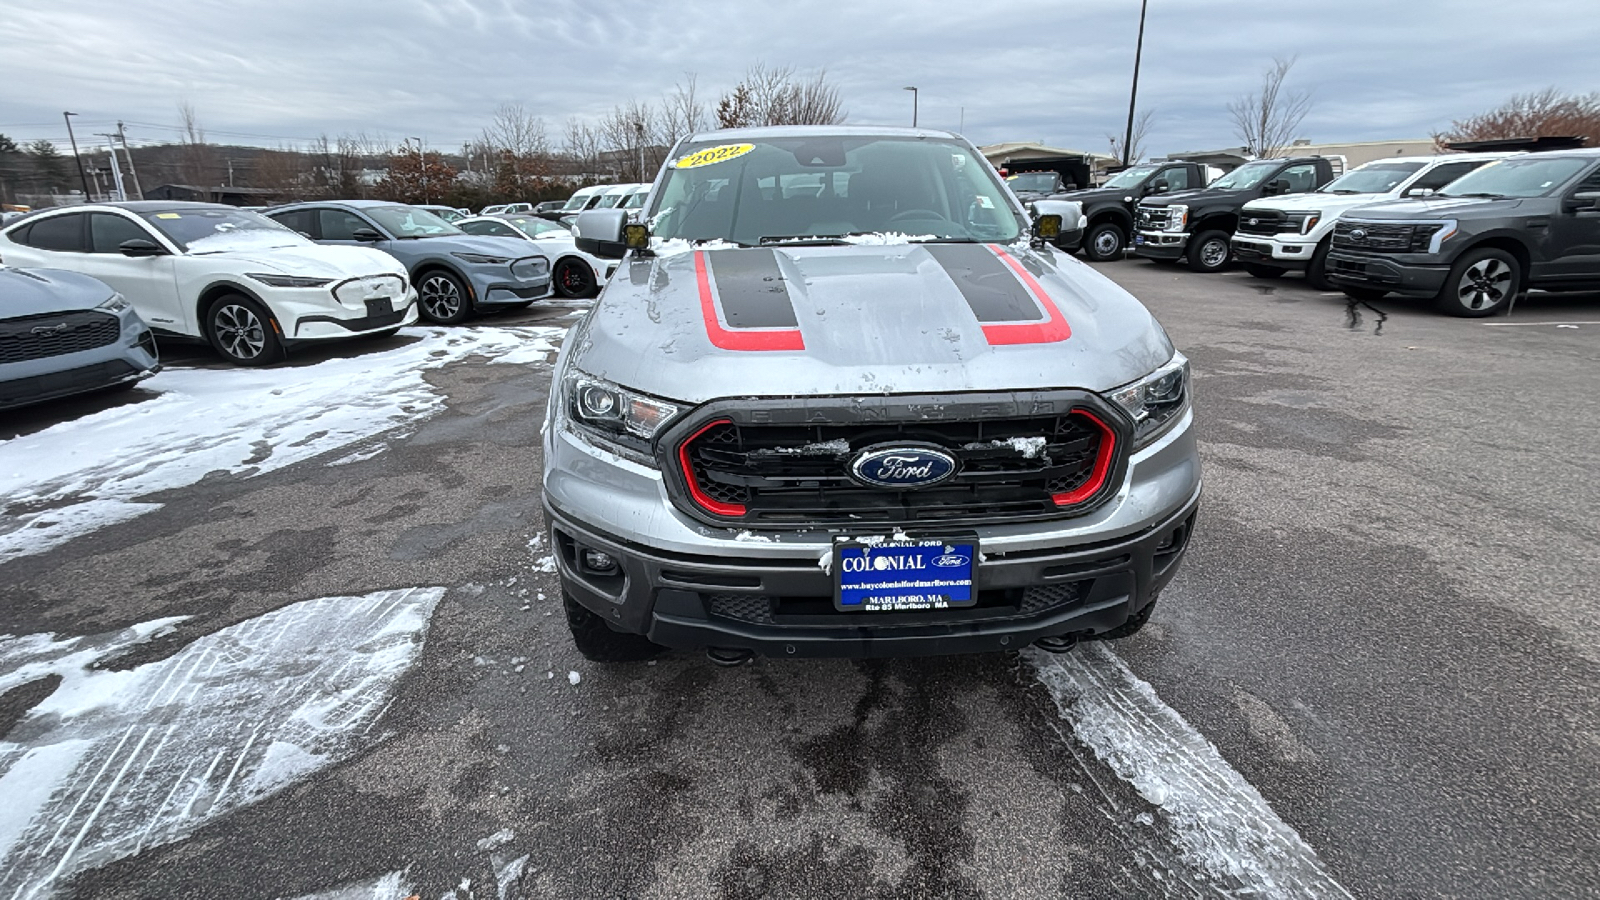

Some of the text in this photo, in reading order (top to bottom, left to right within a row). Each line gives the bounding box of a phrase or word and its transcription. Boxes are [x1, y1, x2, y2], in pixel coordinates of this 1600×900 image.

[690, 146, 741, 167] 2022
[877, 456, 934, 479] Ford
[842, 555, 926, 572] COLNIAL
[938, 556, 963, 565] Ford
[865, 601, 949, 611] Rte 85 Marlboro MA
